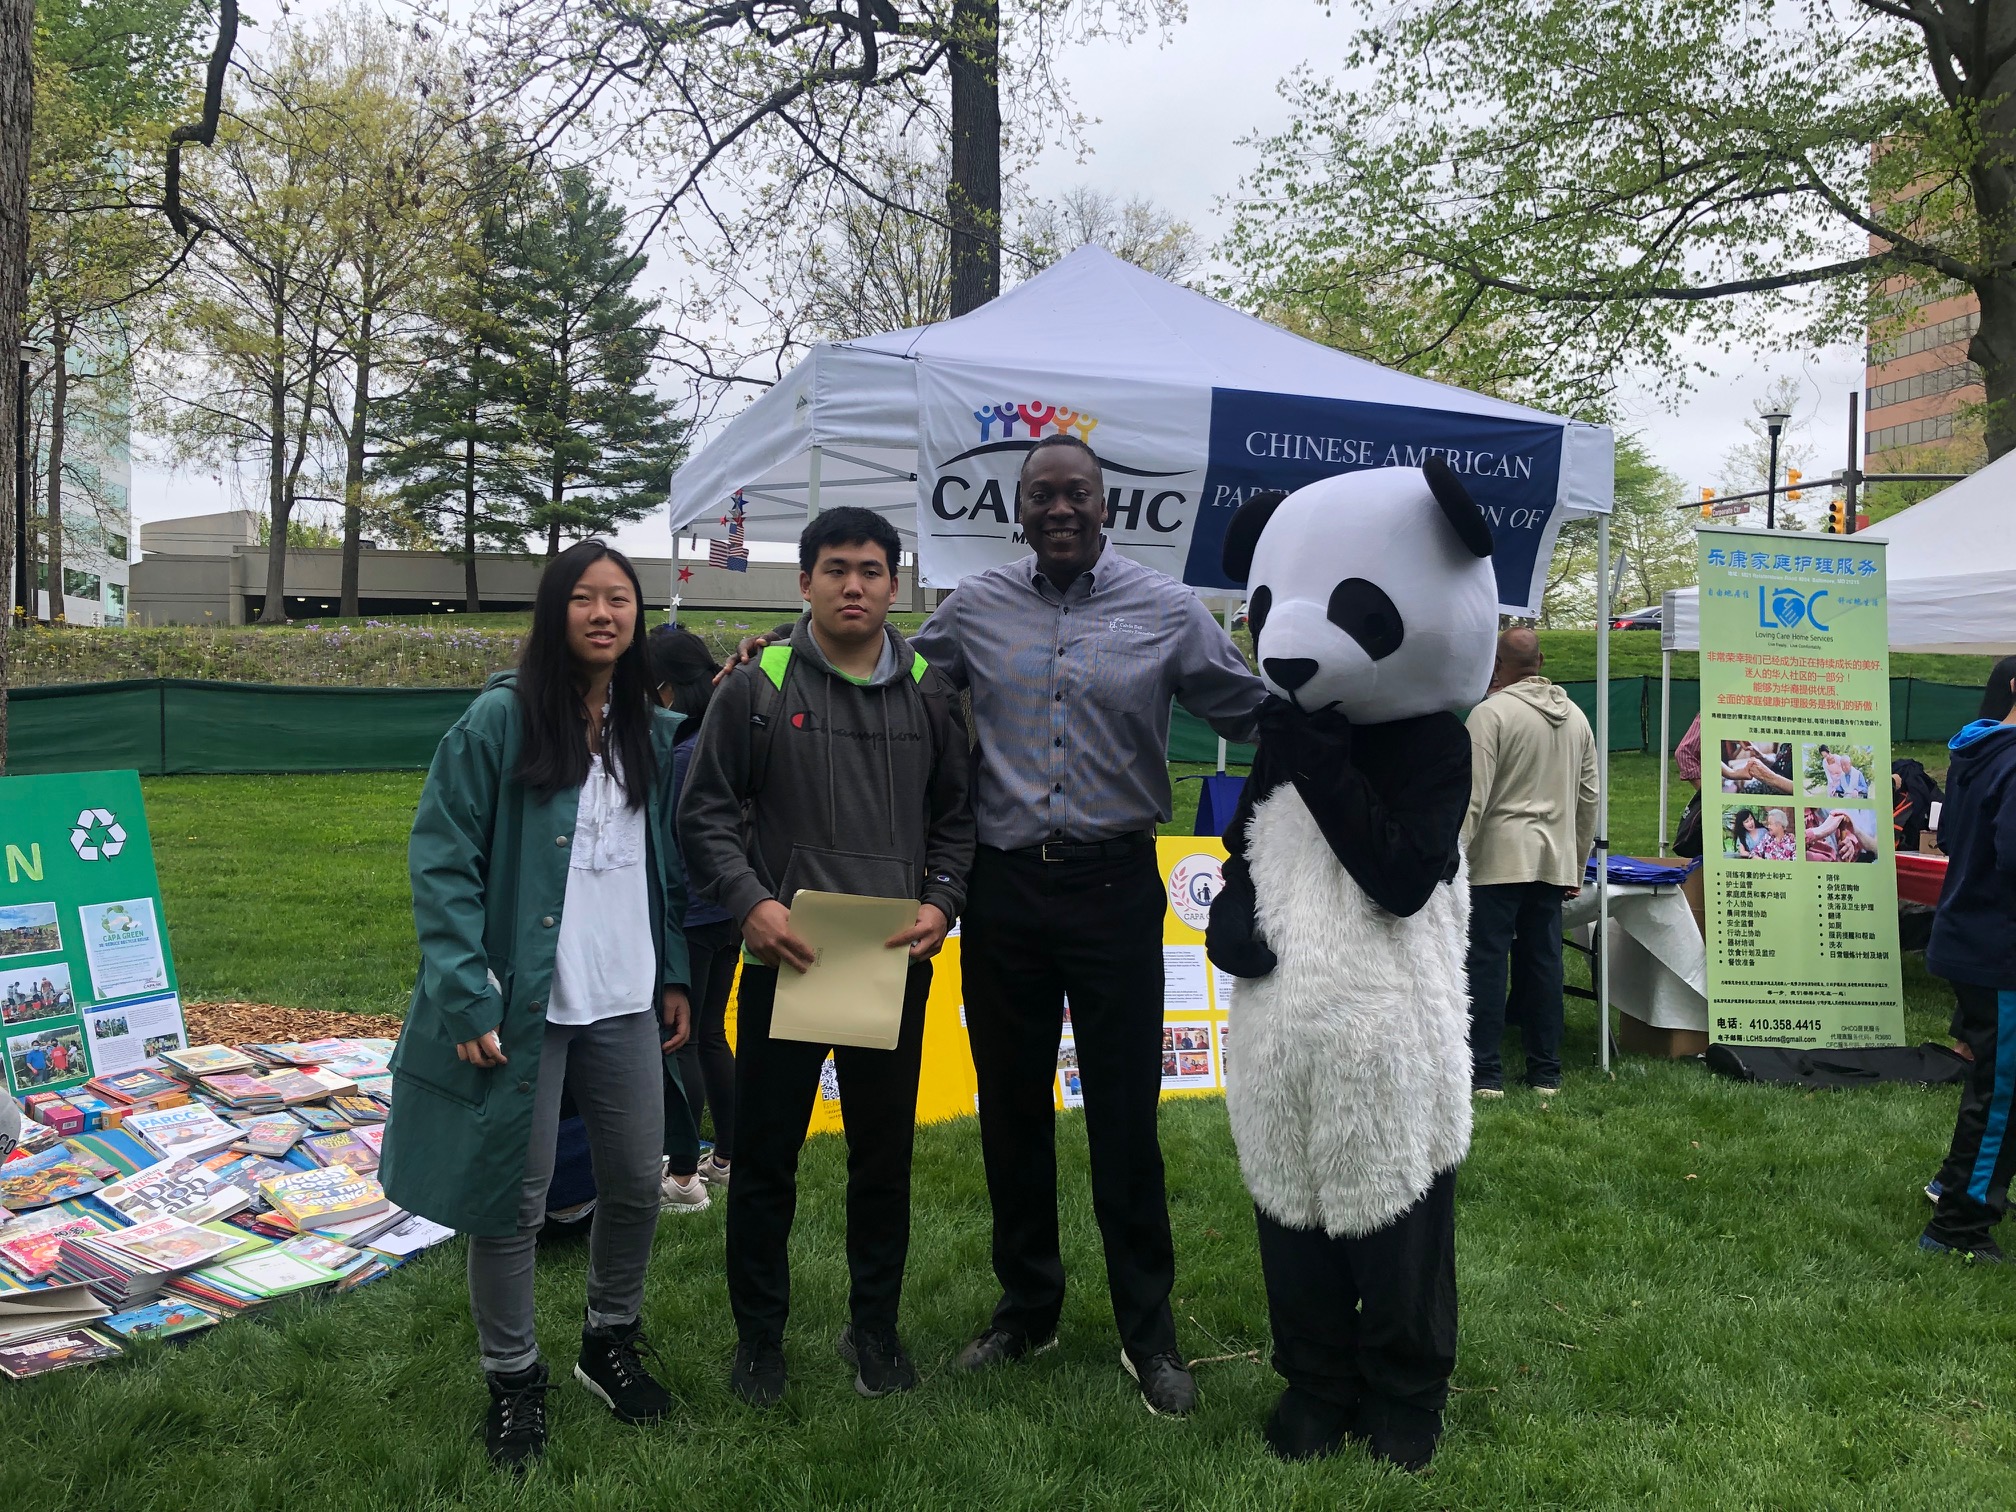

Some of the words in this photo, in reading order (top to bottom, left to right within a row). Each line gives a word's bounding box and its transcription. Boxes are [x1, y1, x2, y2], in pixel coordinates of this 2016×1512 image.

[1245, 431, 1374, 466] CHINESE
[931, 475, 1187, 533] CAHC
[1509, 508, 1544, 530] OF
[1755, 631, 1775, 641] Loving
[1776, 632, 1791, 640] Care
[1792, 633, 1809, 642] Home
[1810, 634, 1834, 643] Services
[1183, 913, 1205, 921] CAPA
[102, 933, 121, 943] CAPA
[122, 930, 144, 940] GREEN
[1749, 1019, 1822, 1031] 410.358.4415
[138, 1111, 199, 1128] PARCC
[126, 1172, 165, 1192] FIRST
[274, 1165, 351, 1190] BIGGEST
[287, 1176, 348, 1191] BOOK
[333, 1181, 368, 1194] THE
